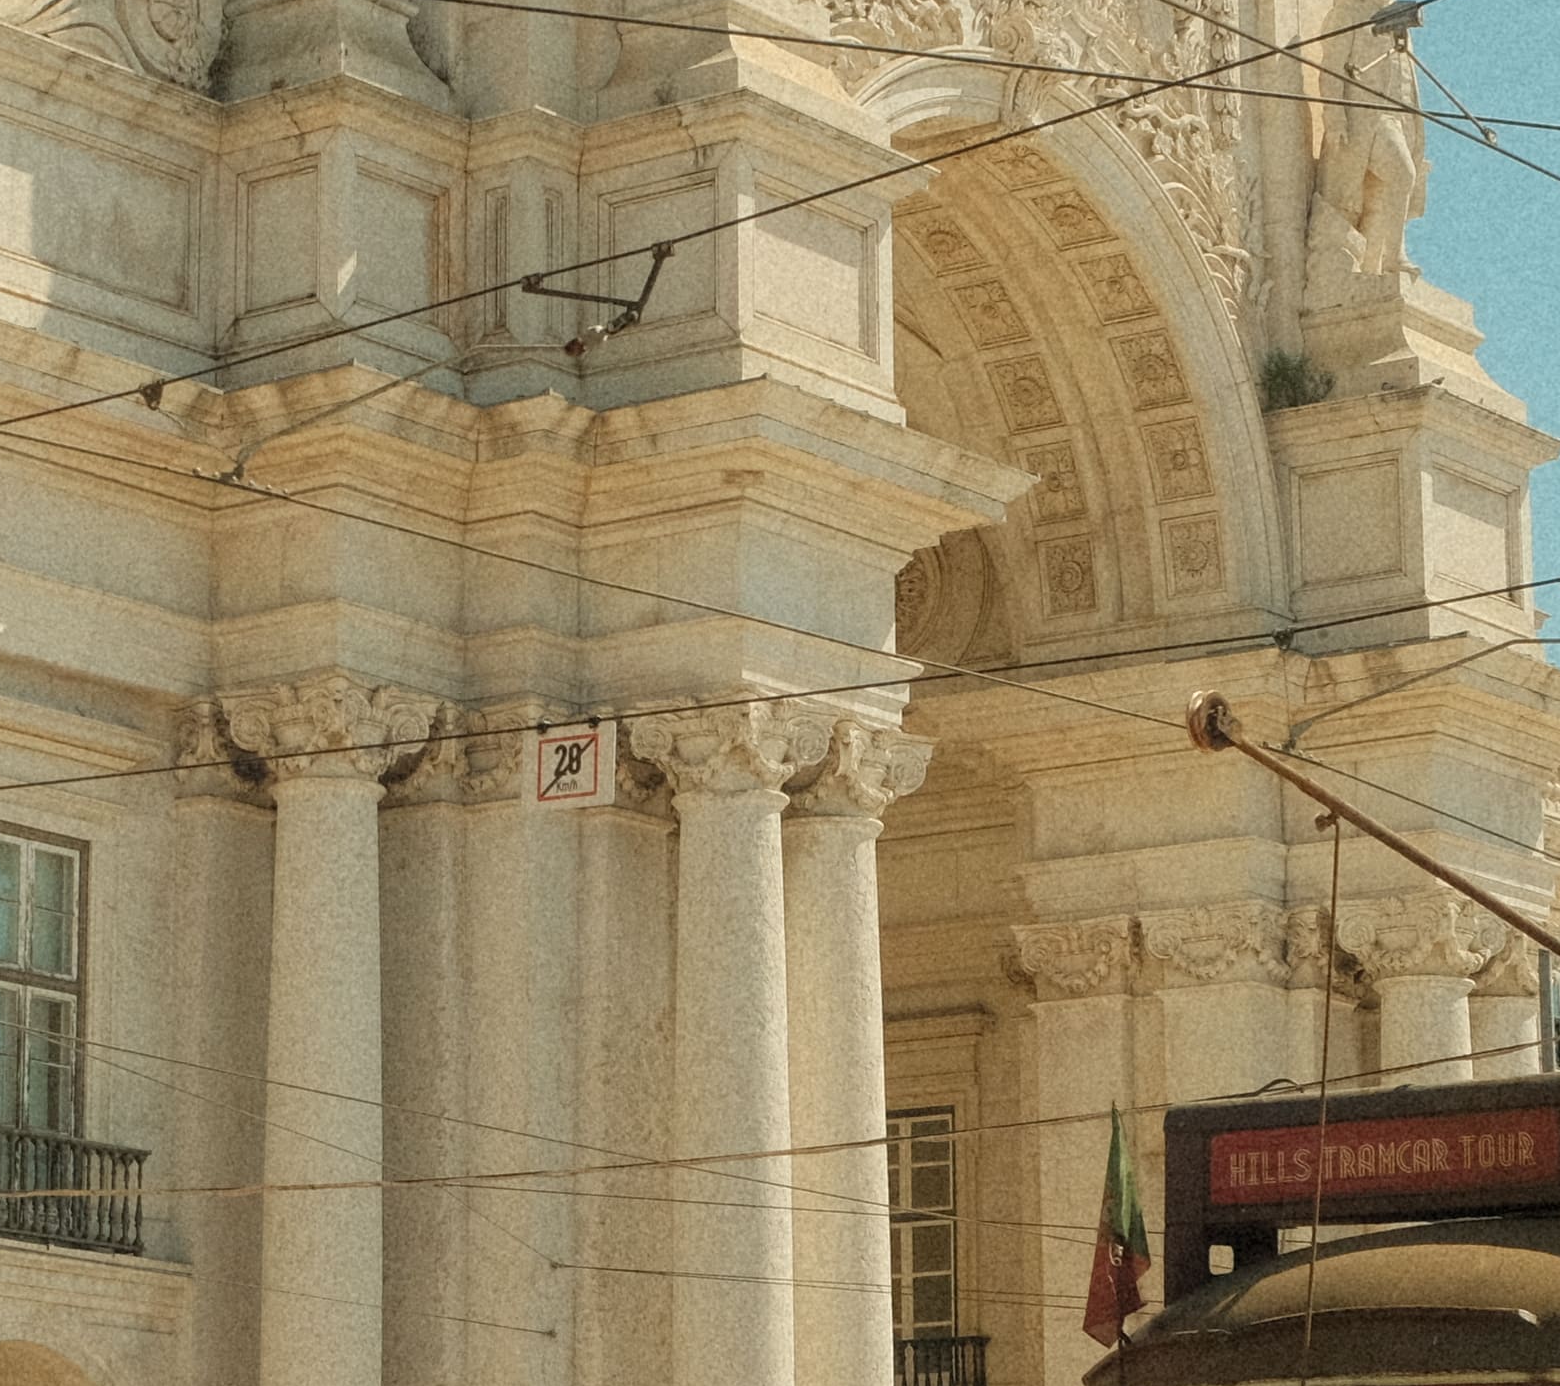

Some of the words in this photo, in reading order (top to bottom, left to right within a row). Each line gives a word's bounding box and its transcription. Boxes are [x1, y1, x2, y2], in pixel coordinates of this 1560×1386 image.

[1229, 1148, 1313, 1187] HILLS
[1322, 1138, 1450, 1180] TRAMCAR
[1458, 1131, 1537, 1169] TOUR
